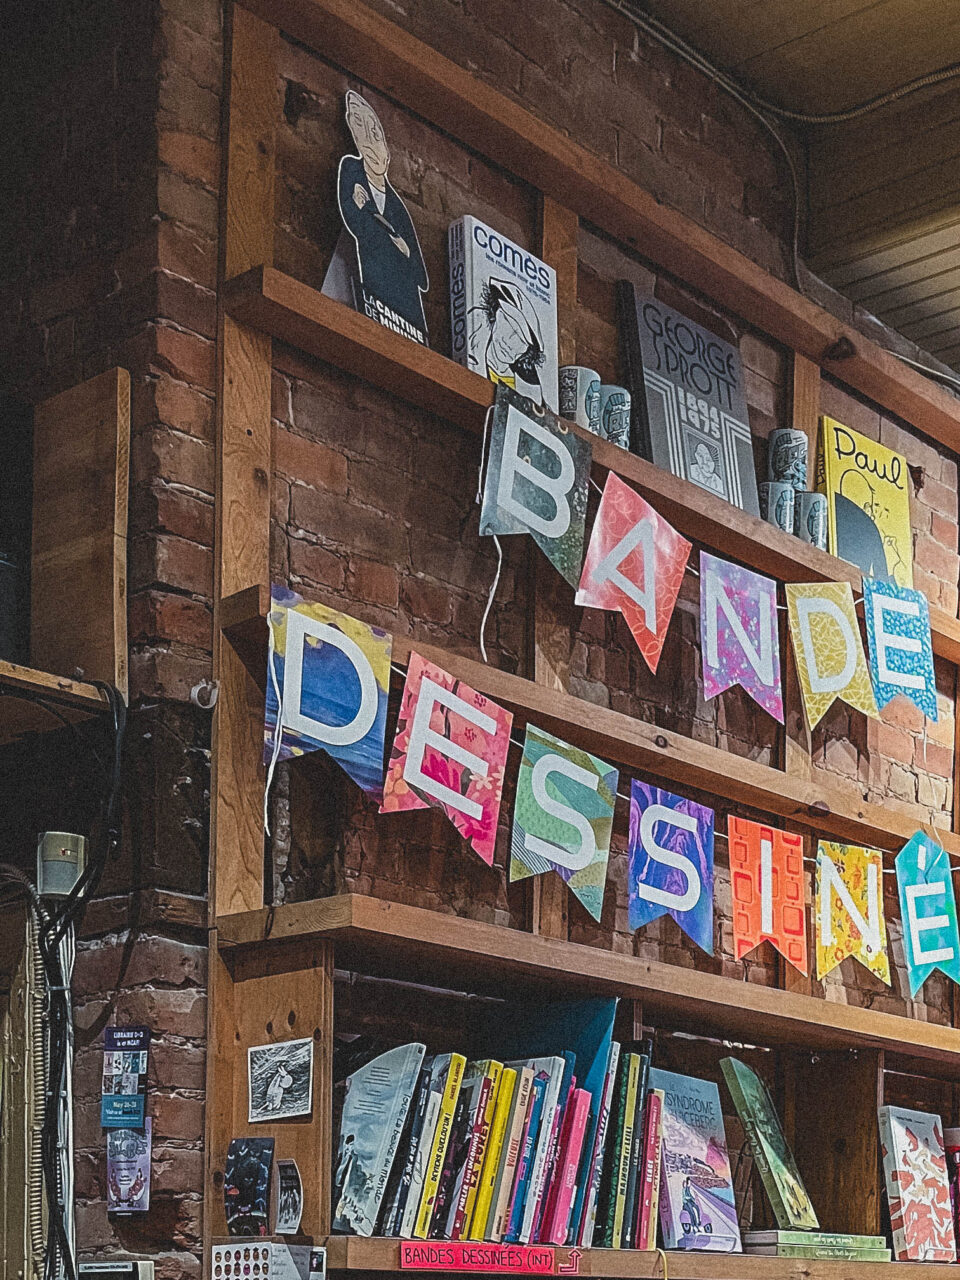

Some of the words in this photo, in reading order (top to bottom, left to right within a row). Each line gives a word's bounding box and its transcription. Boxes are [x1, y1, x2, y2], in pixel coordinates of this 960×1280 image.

[474, 226, 550, 290] comès
[376, 300, 424, 343] CANTINE
[452, 262, 466, 352] comès
[643, 303, 736, 384] GEORGE
[833, 427, 904, 489] Paul
[497, 404, 926, 693] BANDE
[666, 1092, 714, 1116] SYNDROME
[405, 1248, 454, 1264] BANDES
[462, 1245, 523, 1266] DESSINÉES
[527, 1250, 553, 1270] (INT)
